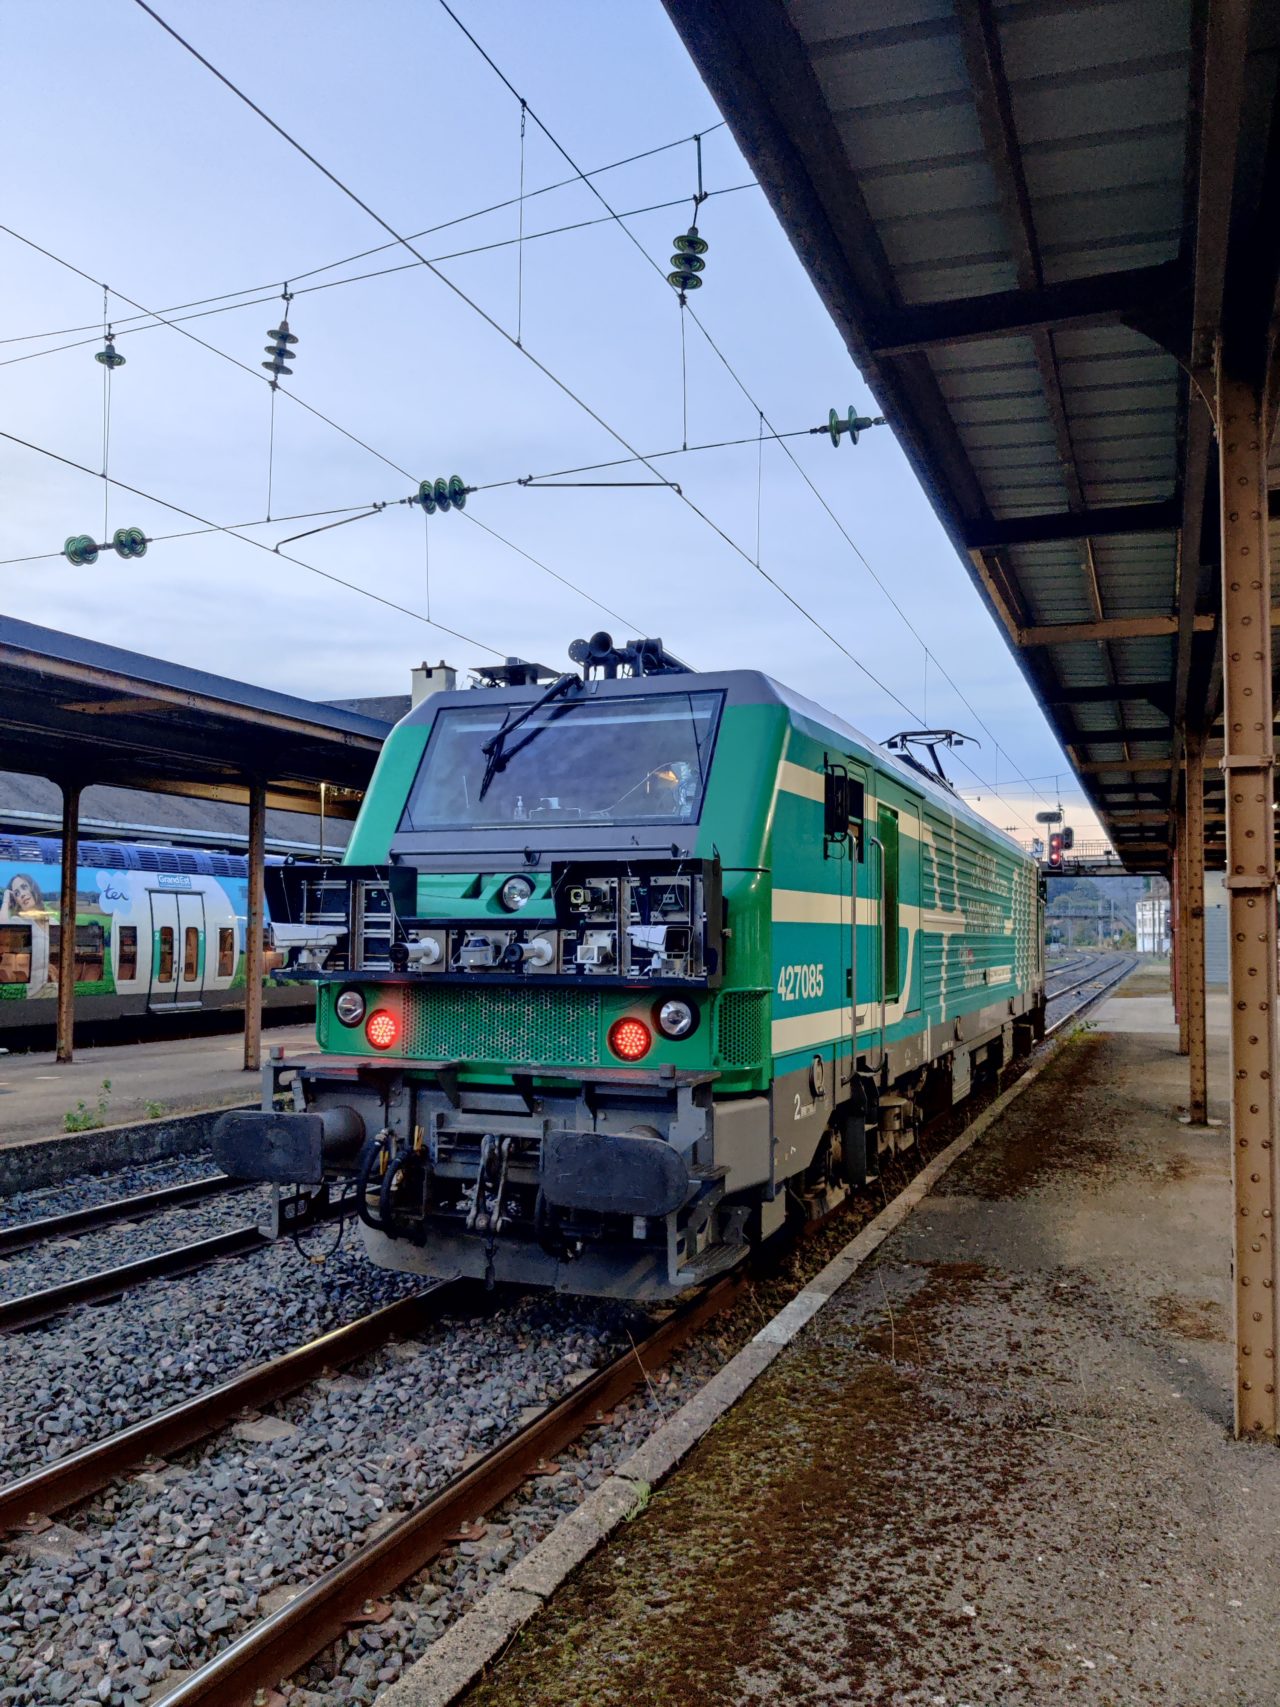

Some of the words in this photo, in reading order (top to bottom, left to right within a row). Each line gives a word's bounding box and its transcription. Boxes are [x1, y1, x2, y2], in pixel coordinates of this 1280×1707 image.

[104, 884, 129, 900] ter
[777, 964, 824, 1001] 427085
[794, 1093, 801, 1121] 2
